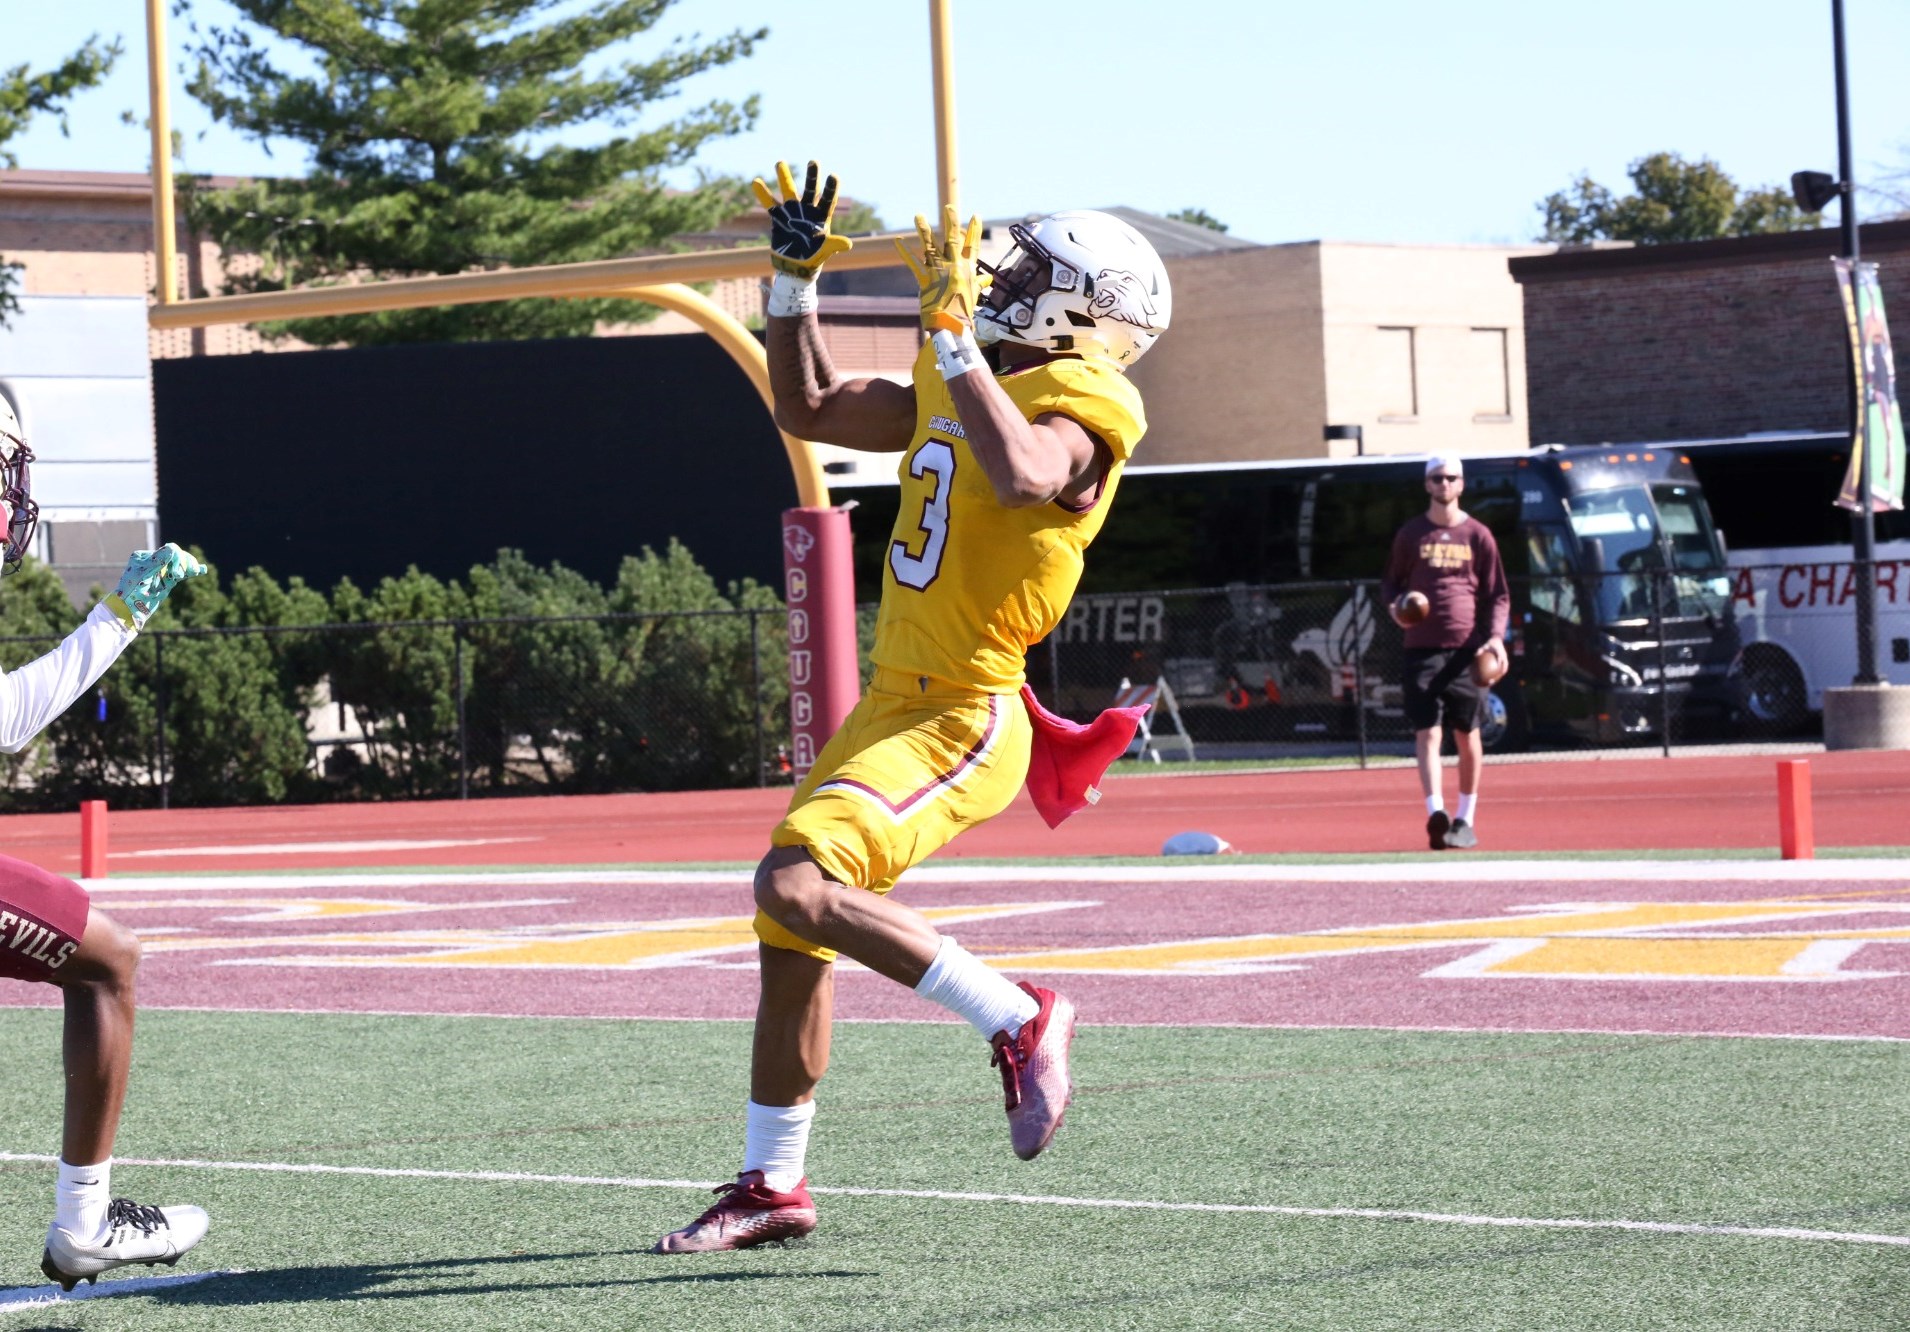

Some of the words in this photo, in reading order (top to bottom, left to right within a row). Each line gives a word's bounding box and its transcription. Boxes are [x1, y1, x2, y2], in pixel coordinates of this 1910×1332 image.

[928, 415, 969, 440] COUGAR
[889, 437, 957, 593] 3
[1053, 597, 1164, 642] RTER
[786, 567, 817, 787] COUGA
